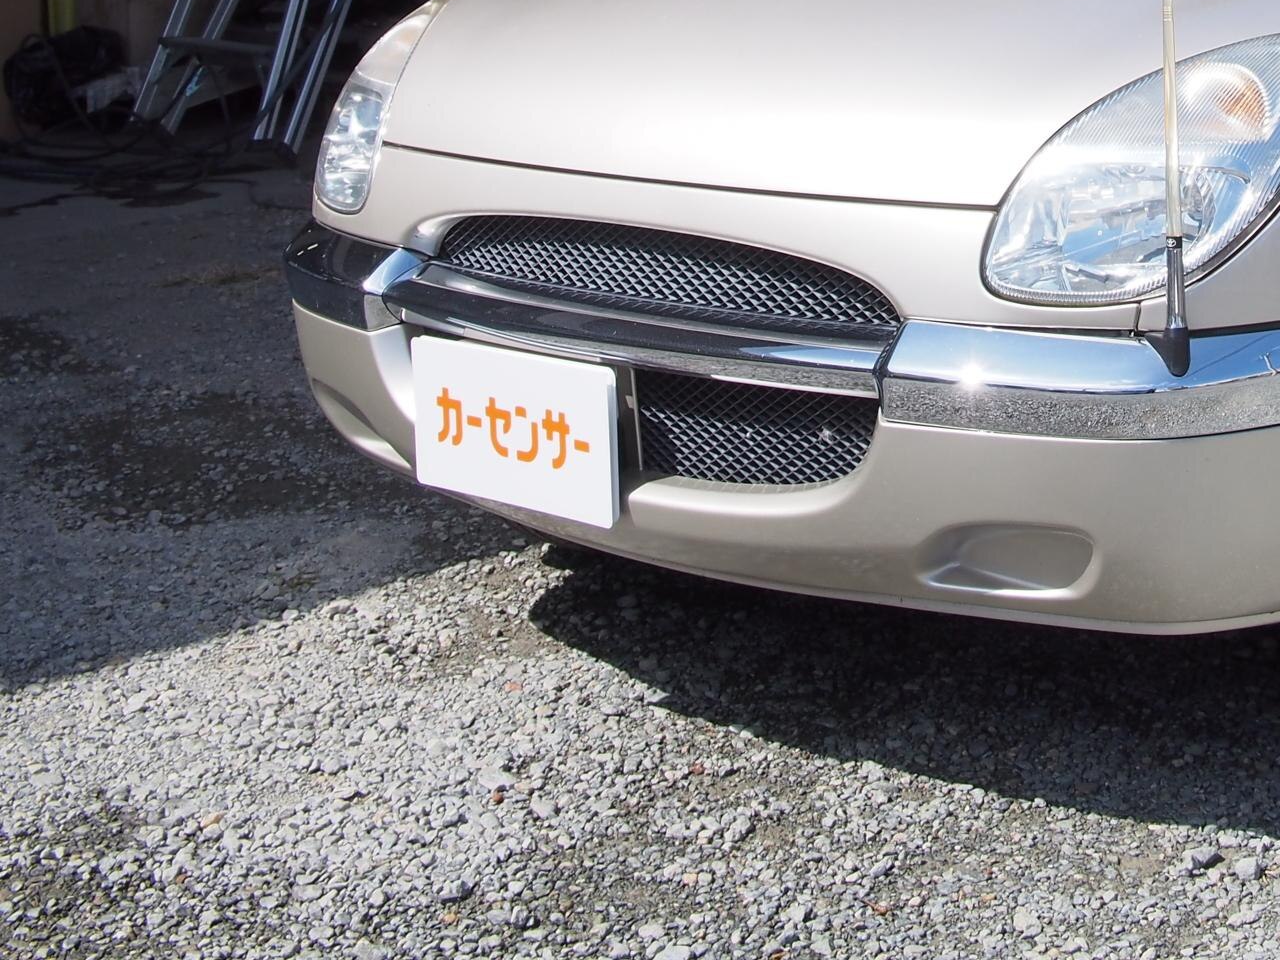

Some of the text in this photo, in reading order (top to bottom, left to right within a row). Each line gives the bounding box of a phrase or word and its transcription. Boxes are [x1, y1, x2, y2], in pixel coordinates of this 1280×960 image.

[436, 387, 590, 470] カーセンサー
